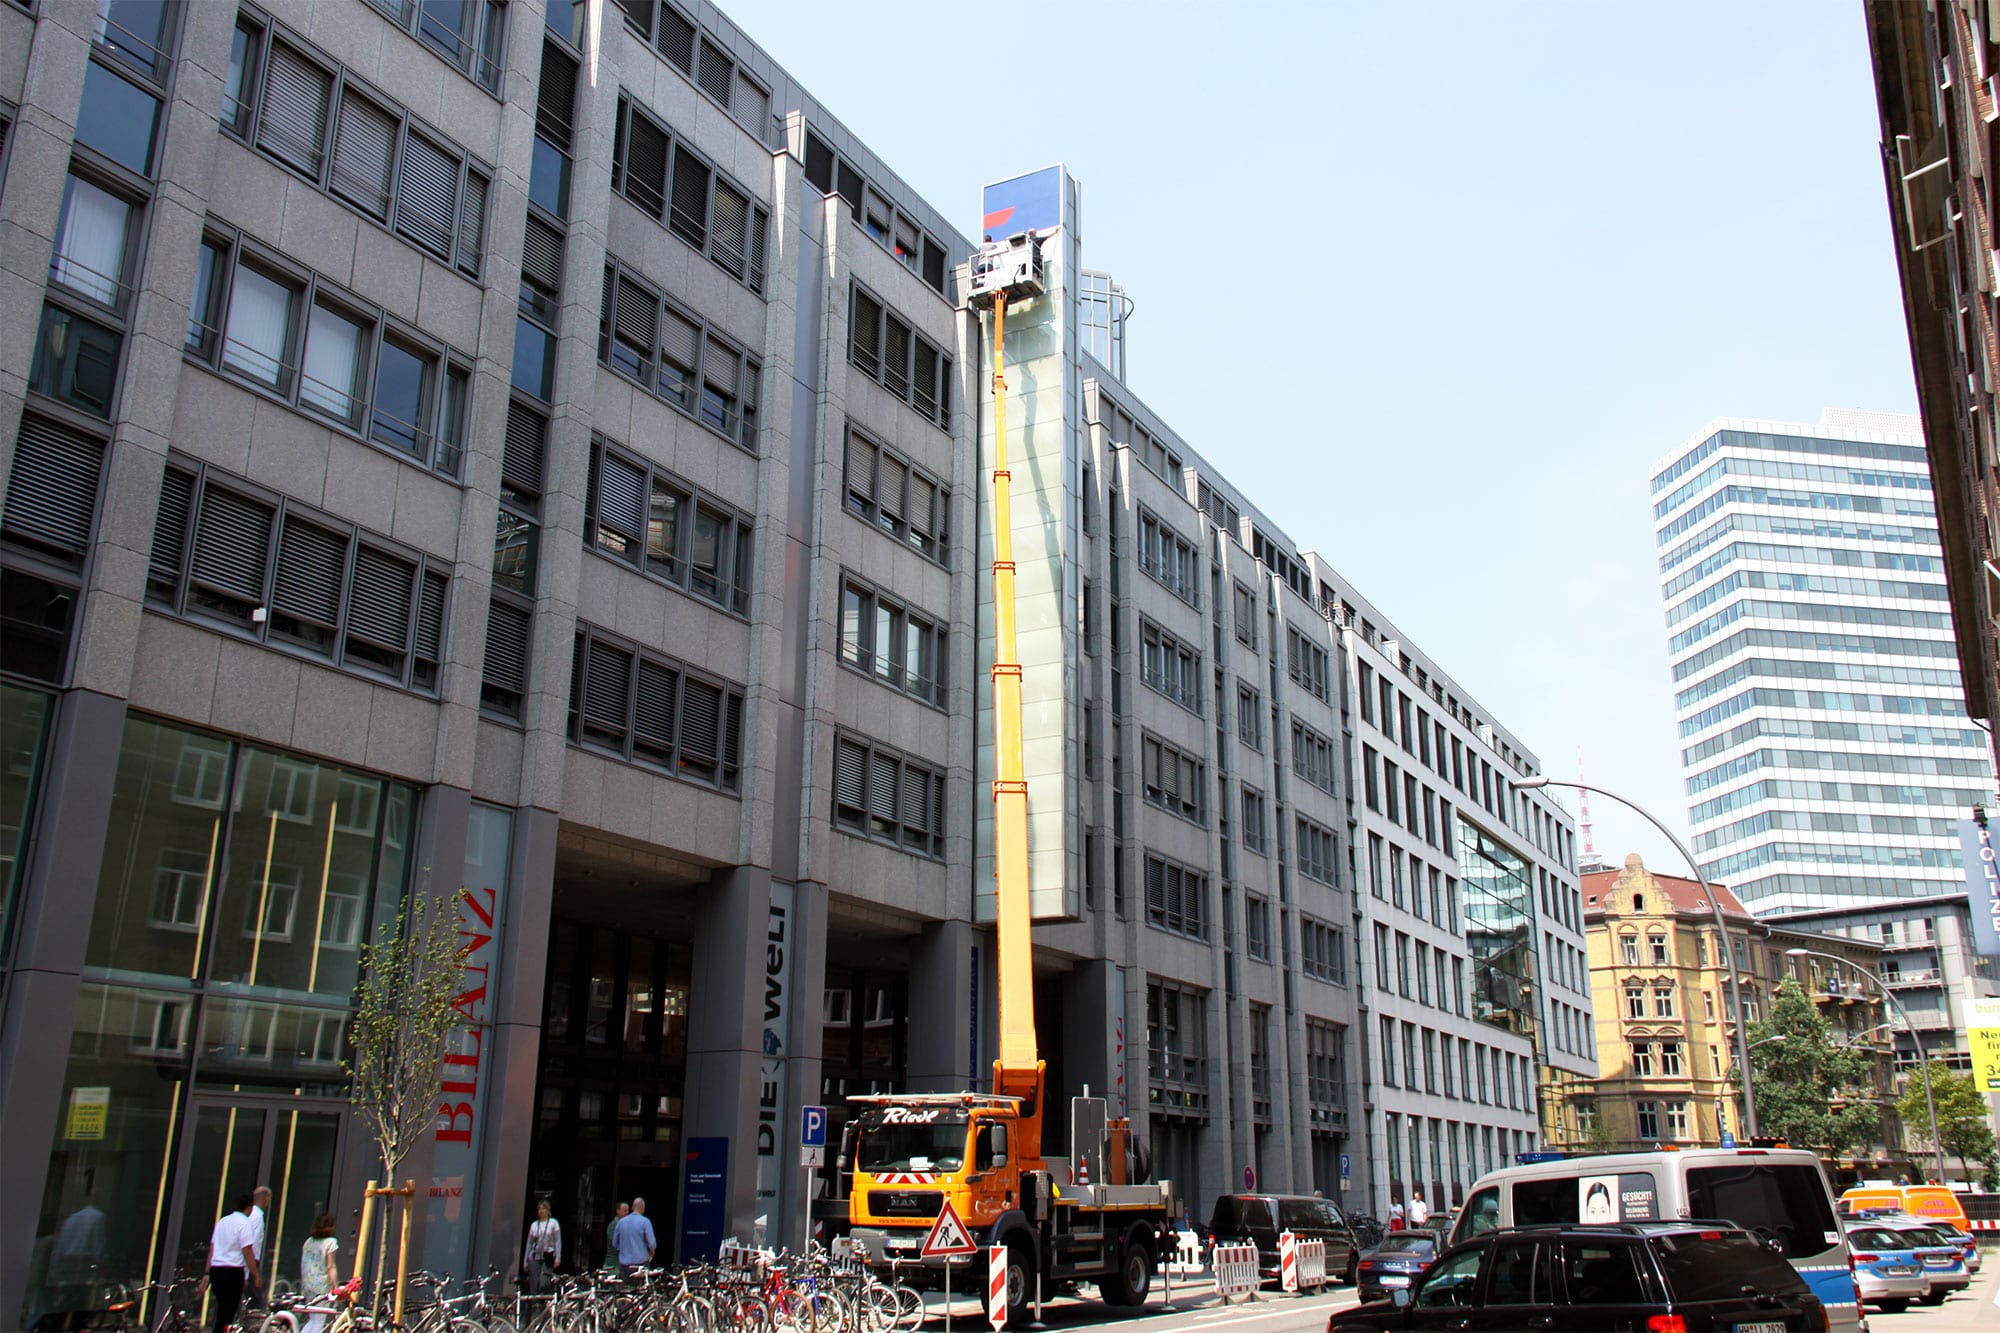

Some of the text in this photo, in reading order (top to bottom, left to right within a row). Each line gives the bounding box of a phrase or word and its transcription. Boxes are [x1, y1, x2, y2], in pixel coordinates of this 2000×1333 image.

[1977, 830, 2000, 945] POLIZE
[435, 885, 496, 1148] BILANZ
[757, 1081, 777, 1156] DIE
[807, 1111, 821, 1141] P
[1342, 1157, 1348, 1174] P
[429, 1187, 462, 1198] BILANZ
[891, 1197, 917, 1207] MAN
[1622, 1191, 1652, 1202] GESUCHT!
